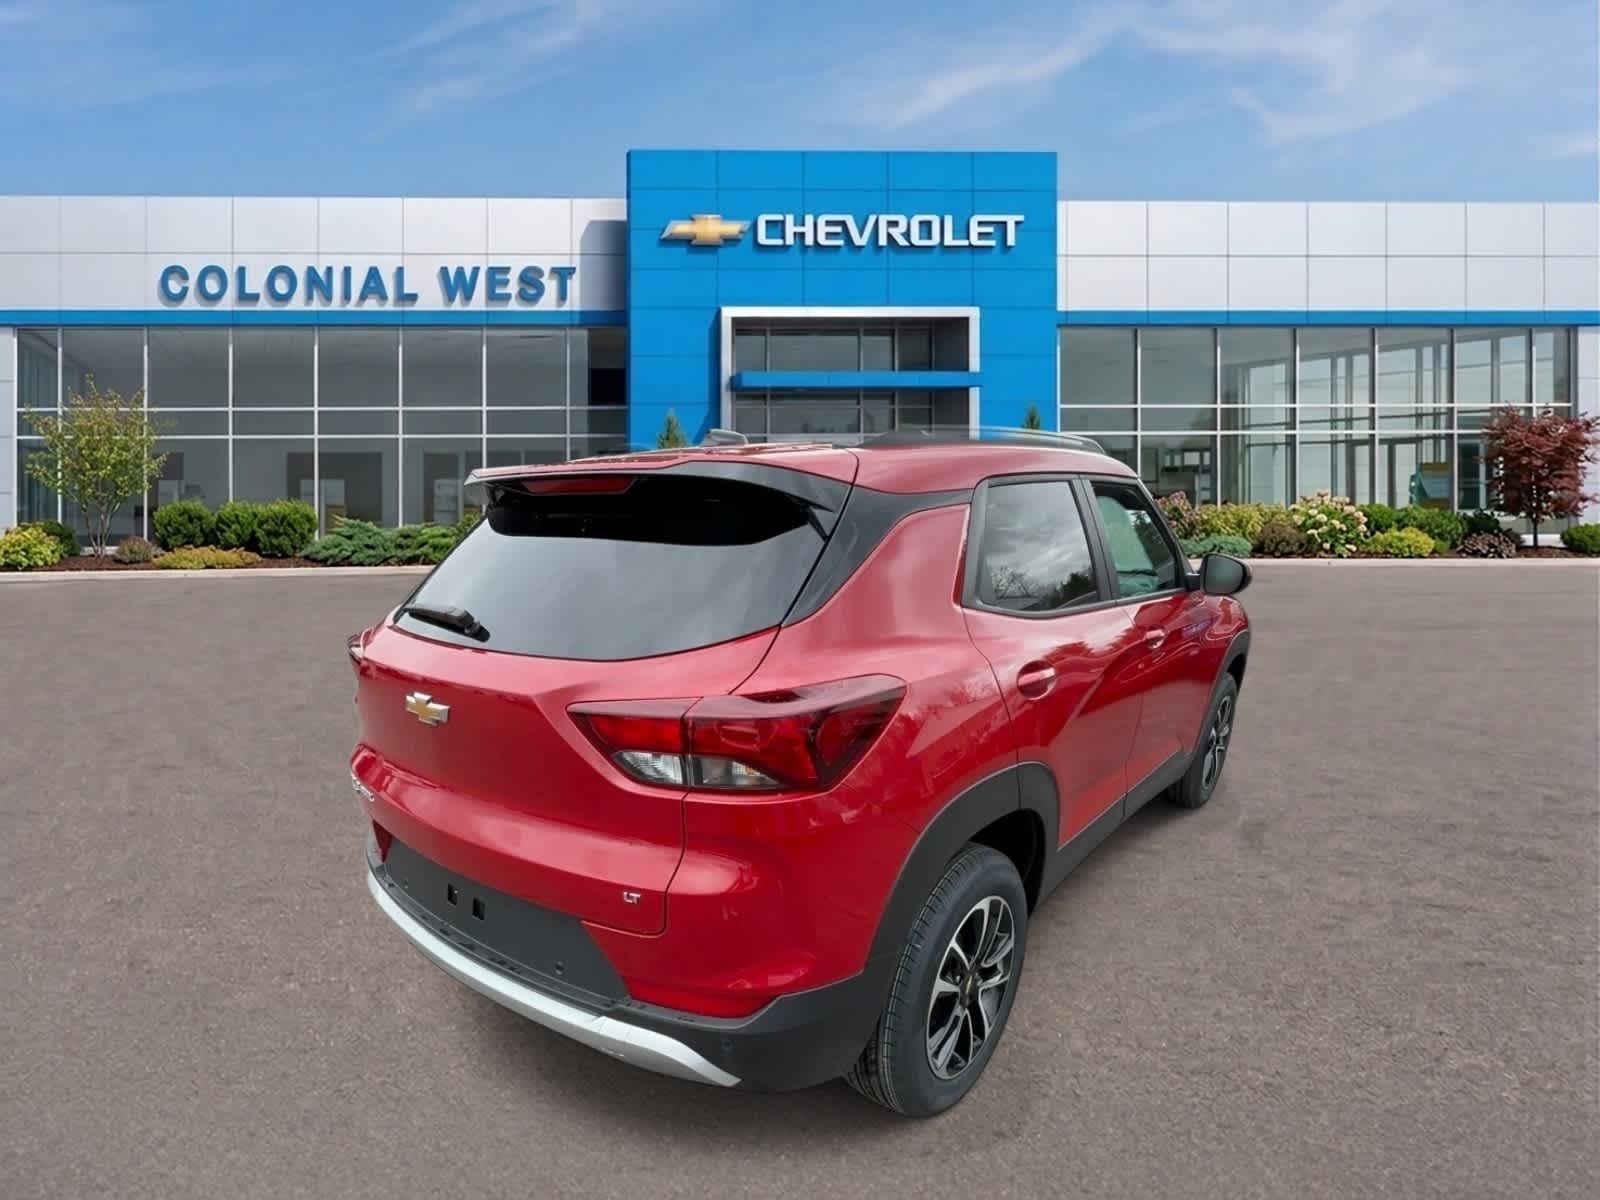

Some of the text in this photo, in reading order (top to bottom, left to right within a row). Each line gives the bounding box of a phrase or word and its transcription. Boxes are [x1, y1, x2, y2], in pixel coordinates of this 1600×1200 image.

[756, 213, 1025, 248] CHEVROLET
[159, 264, 577, 304] COLONIAL WEST
[623, 891, 641, 905] LT
